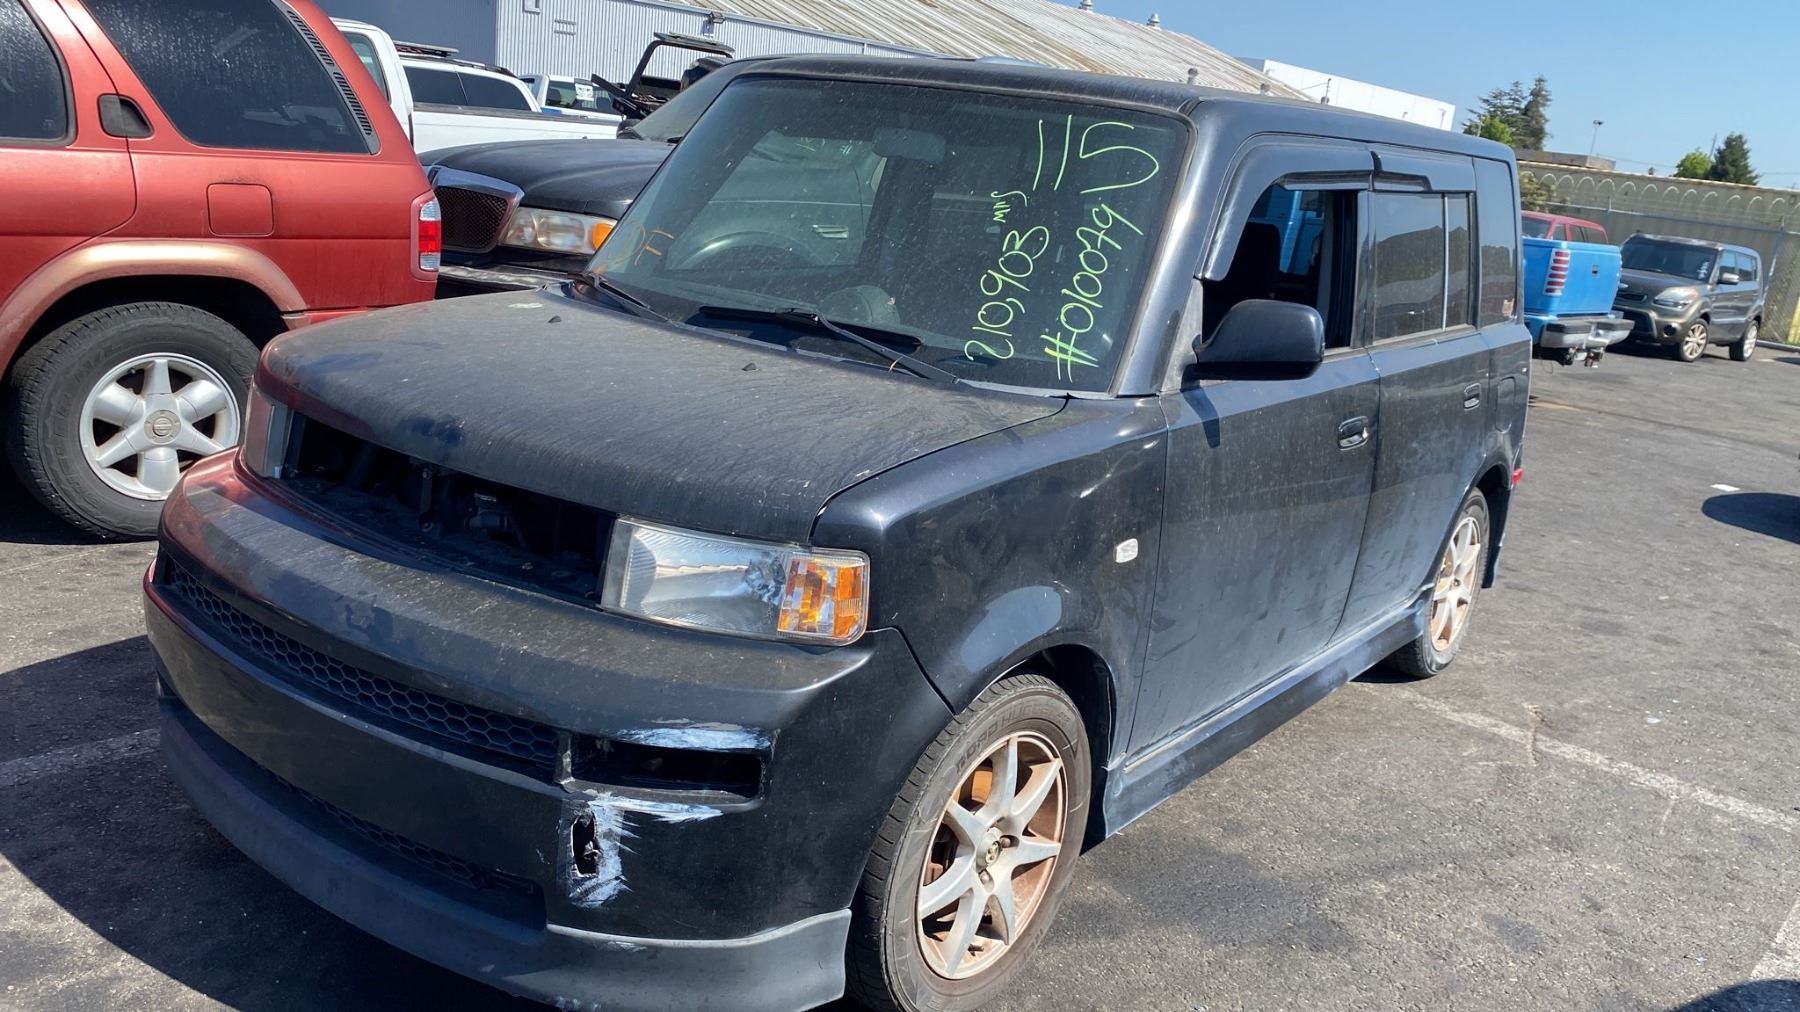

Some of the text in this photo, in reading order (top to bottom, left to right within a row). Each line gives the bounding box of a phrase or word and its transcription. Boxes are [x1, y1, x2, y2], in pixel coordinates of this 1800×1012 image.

[1032, 114, 1160, 194] 115
[963, 225, 1050, 361] 210,903
[1040, 203, 1144, 383] #010079
